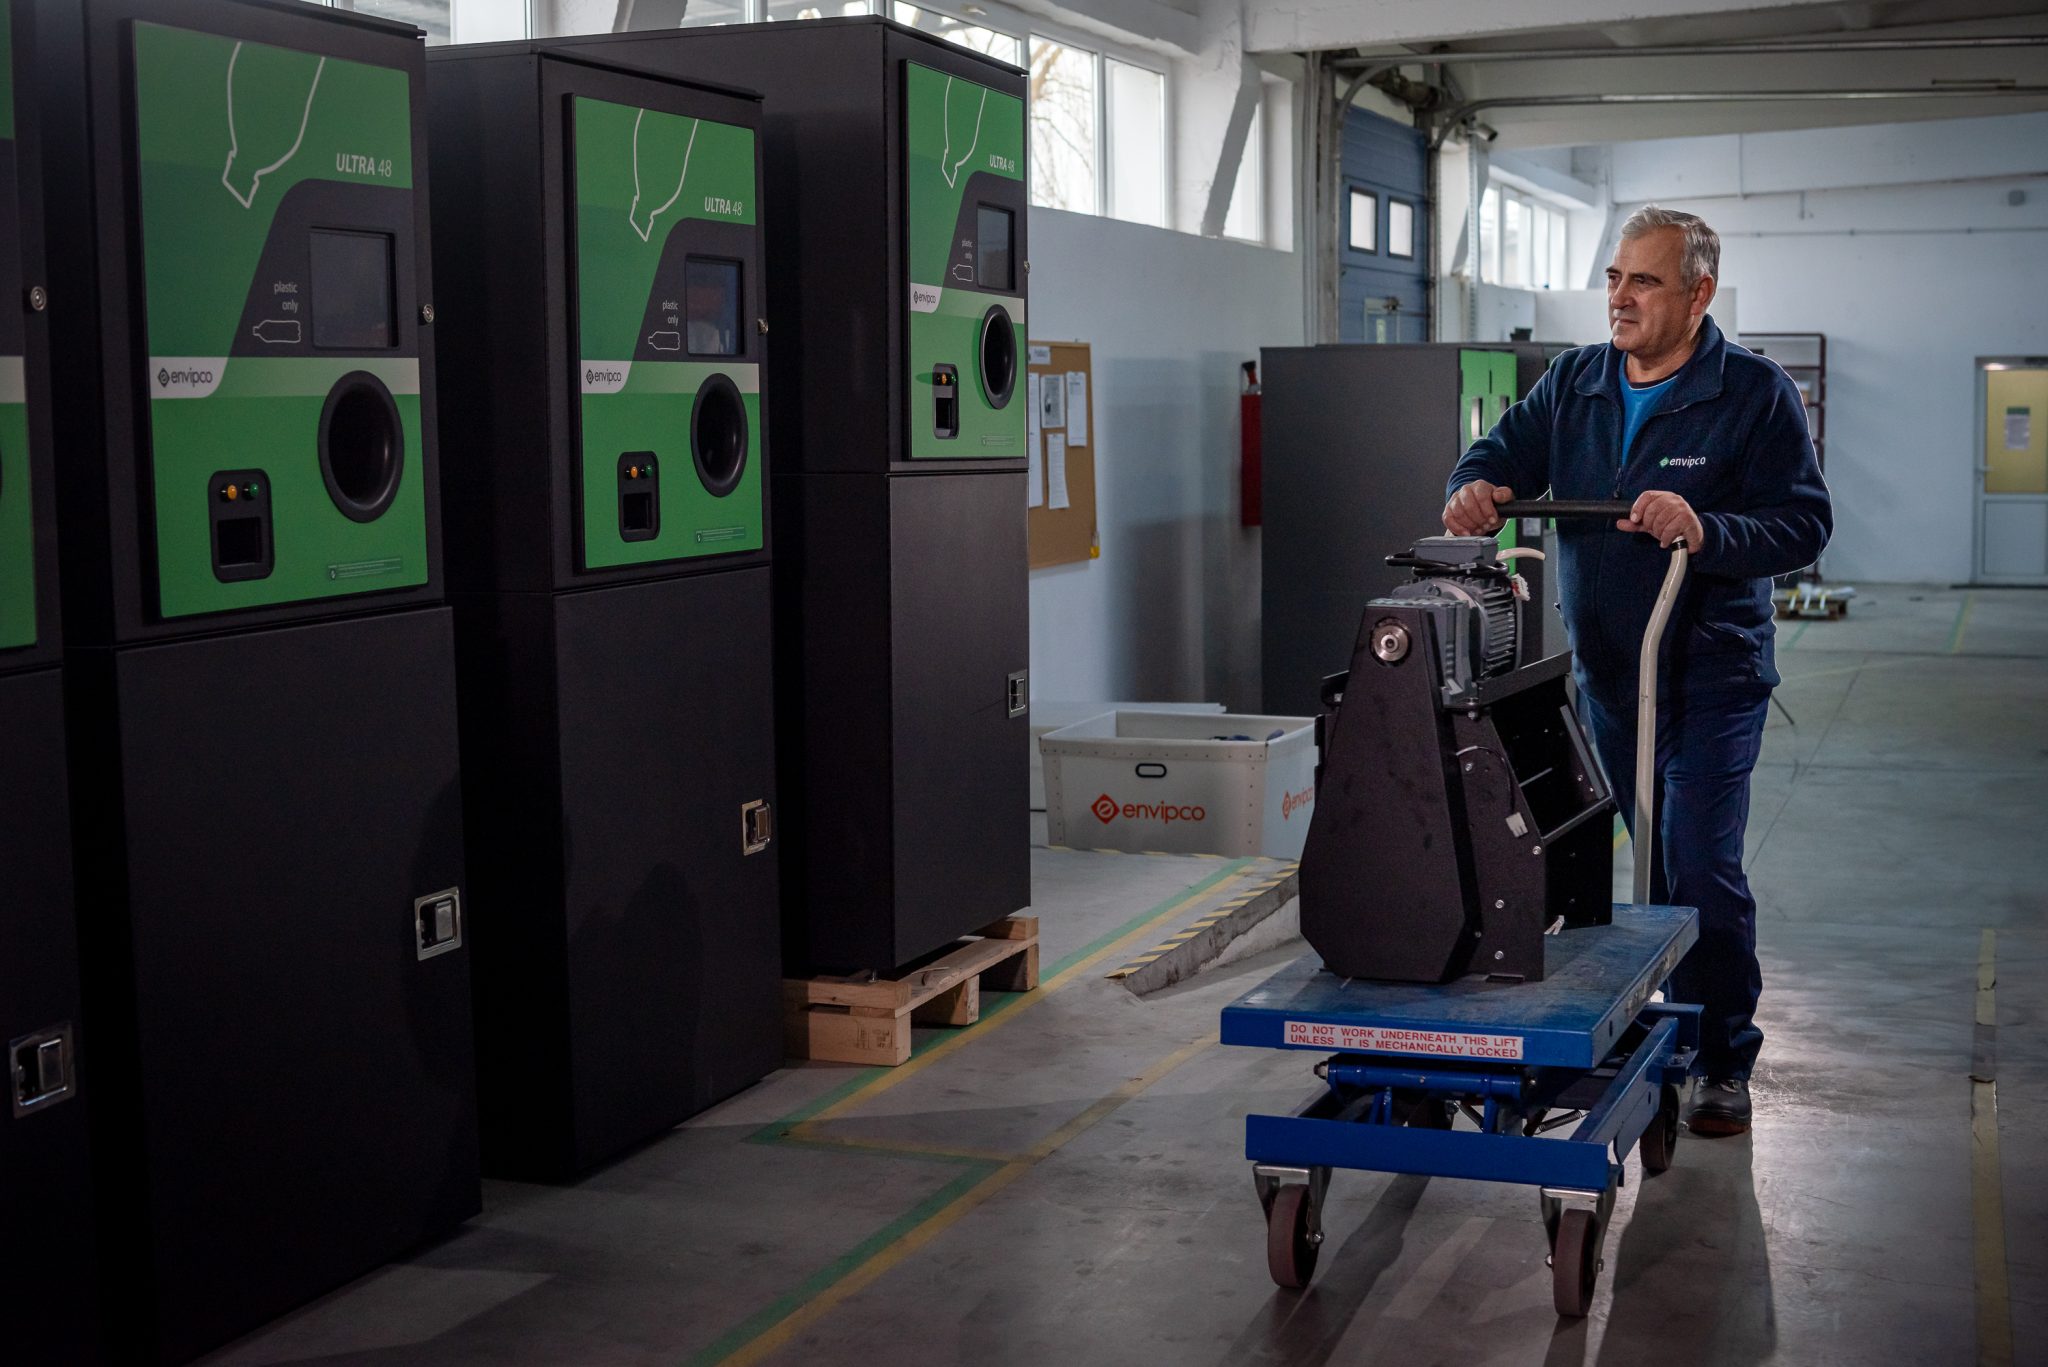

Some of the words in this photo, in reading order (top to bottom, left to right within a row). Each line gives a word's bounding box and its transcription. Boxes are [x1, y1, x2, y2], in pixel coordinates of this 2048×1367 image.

[336, 153, 375, 175] ULTRA
[378, 159, 392, 177] 48
[990, 154, 1007, 171] ULTRA
[1007, 159, 1015, 173] 48
[704, 196, 731, 215] ULTRA
[732, 202, 743, 216] 48
[274, 281, 298, 294] plastic
[282, 300, 299, 313] only
[662, 299, 679, 311] plastic
[667, 314, 679, 326] only
[171, 366, 213, 388] envipco
[595, 369, 621, 385] envipco
[1669, 456, 1706, 468] envipco
[1122, 800, 1205, 824] envipco
[1291, 1024, 1306, 1033] DO
[1312, 1026, 1335, 1035] NOT
[1341, 1028, 1375, 1038] WORK
[1381, 1030, 1457, 1043] UNDERNEATH
[1463, 1035, 1488, 1046] THIS
[1494, 1038, 1517, 1047] LIFT
[1291, 1035, 1334, 1045] UNLESS
[1343, 1038, 1353, 1047] IT
[1360, 1039, 1369, 1048] IS
[1375, 1040, 1464, 1054] MECHANICALLY
[1470, 1046, 1518, 1057] LOCKED
